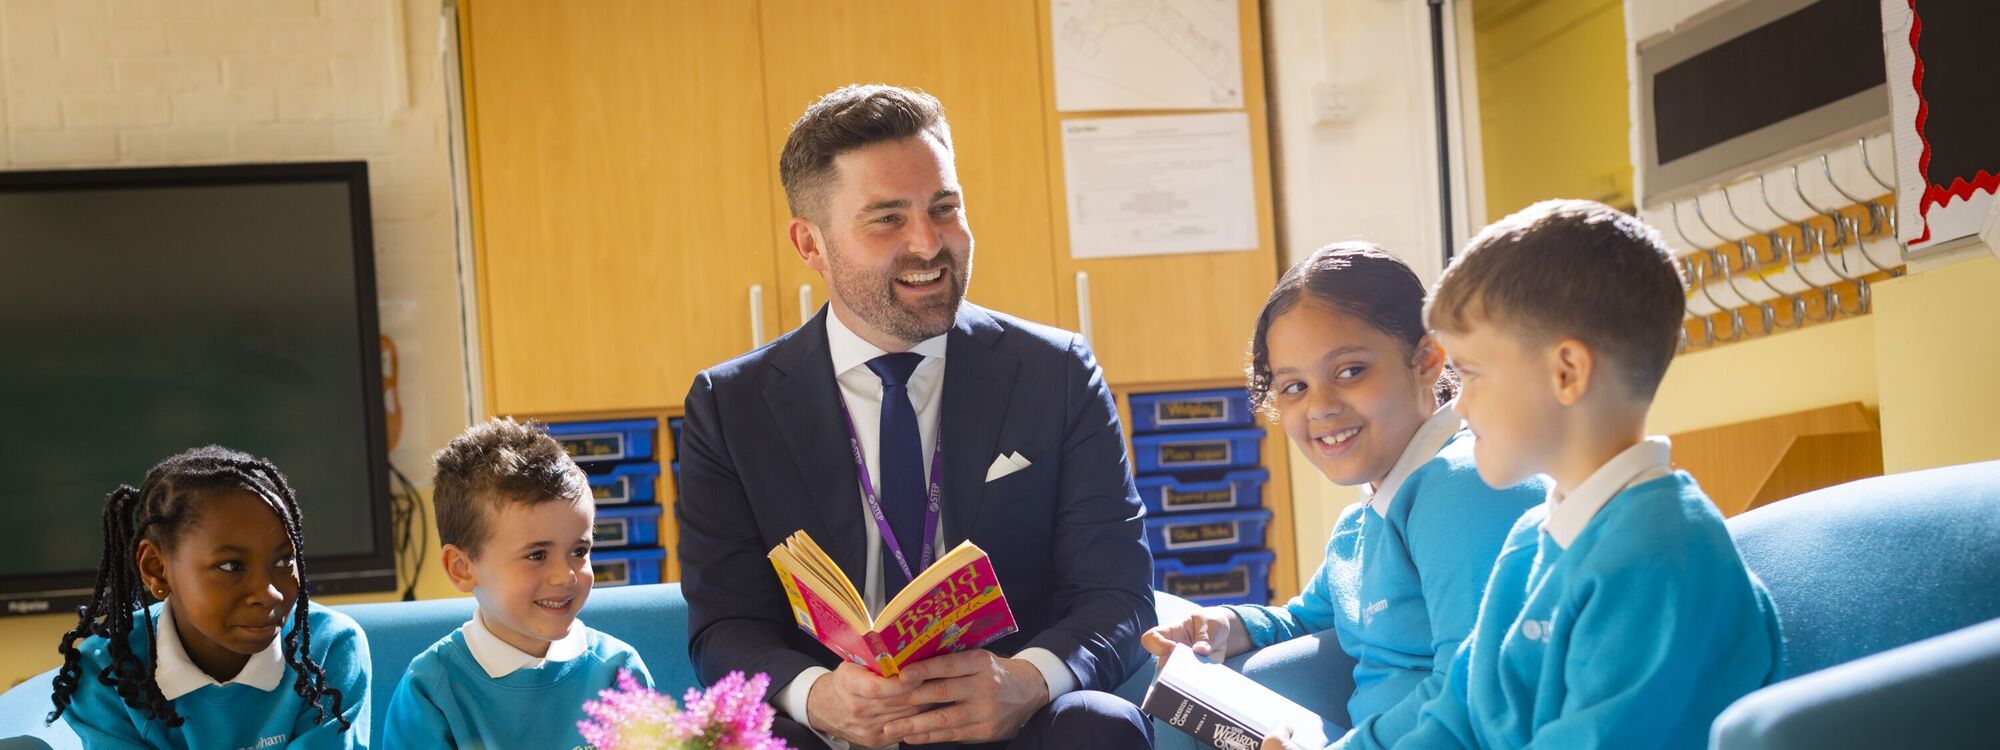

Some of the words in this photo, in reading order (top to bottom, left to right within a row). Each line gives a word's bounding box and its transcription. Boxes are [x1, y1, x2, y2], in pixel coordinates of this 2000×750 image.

[931, 482, 941, 503] STEP
[871, 502, 884, 521] STEP
[891, 563, 980, 640] Roald
[906, 580, 980, 642] Dahl
[1177, 704, 1194, 727] COWELL
[1213, 723, 1259, 750] WIZARDS
